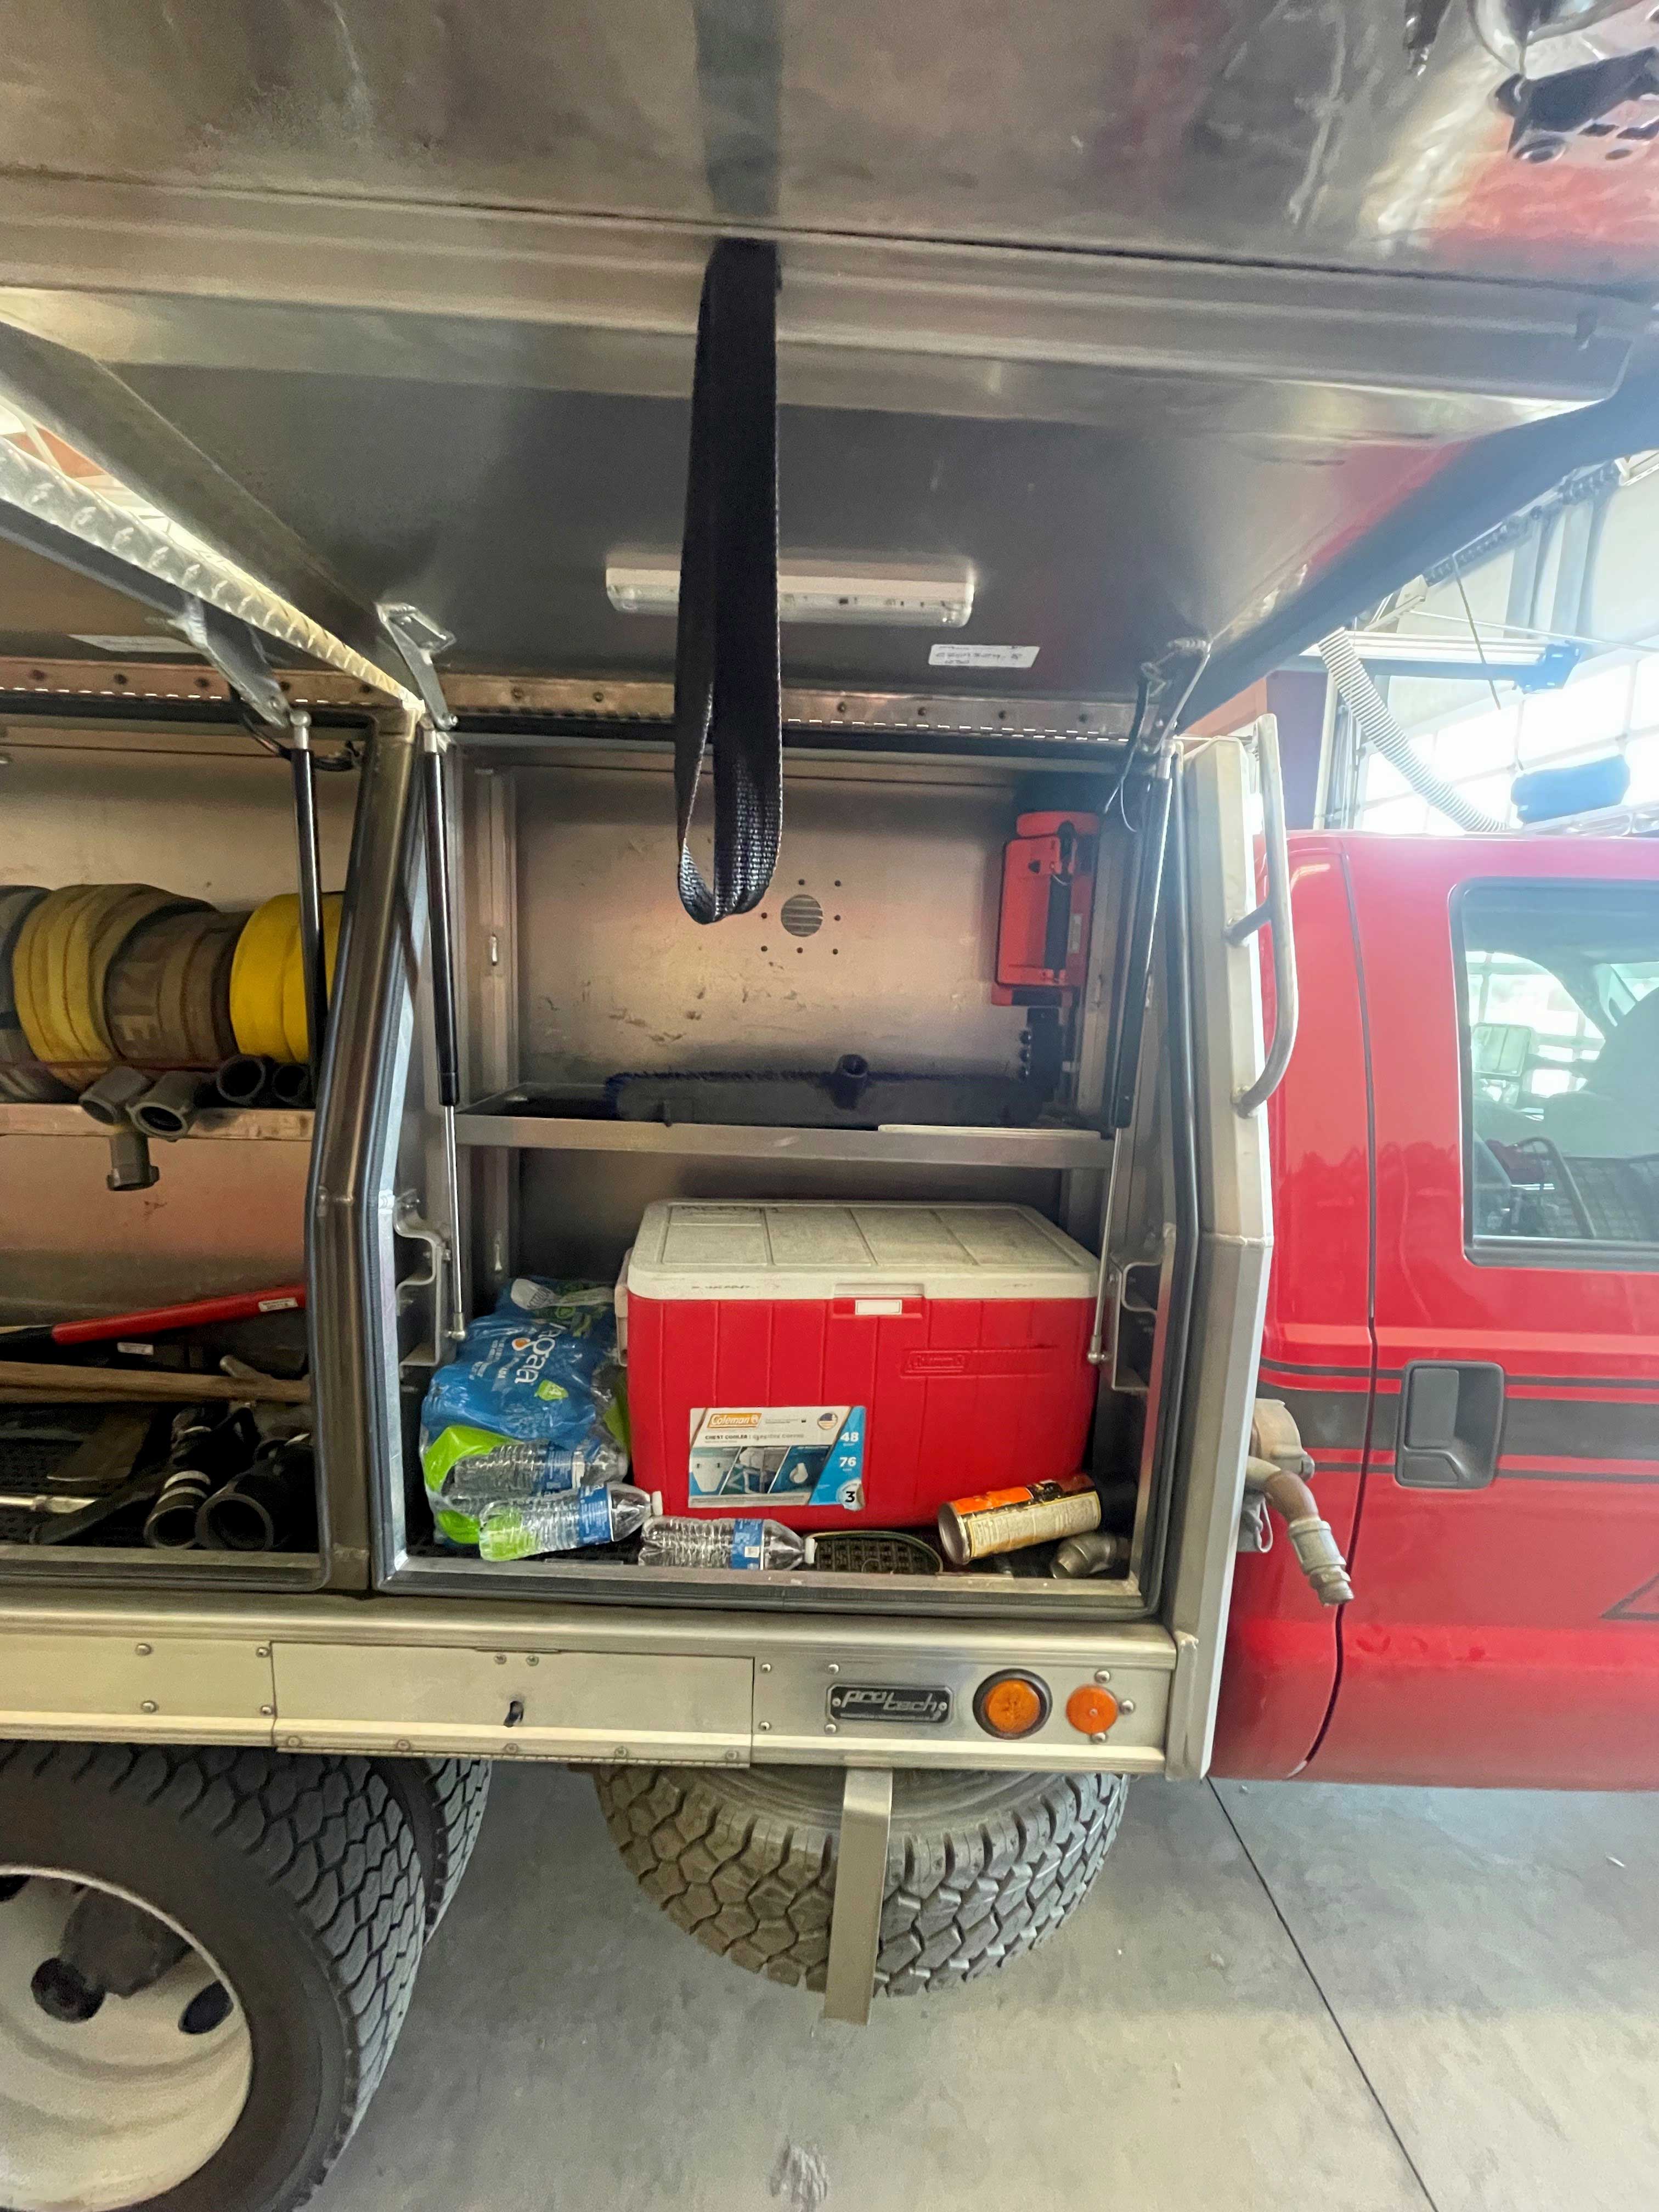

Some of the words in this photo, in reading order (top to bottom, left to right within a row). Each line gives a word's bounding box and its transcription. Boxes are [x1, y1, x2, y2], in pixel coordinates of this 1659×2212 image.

[711, 1414, 750, 1425] Coleman
[840, 1432, 859, 1442] 48
[839, 1457, 856, 1467] 76
[845, 1491, 855, 1503] 3
